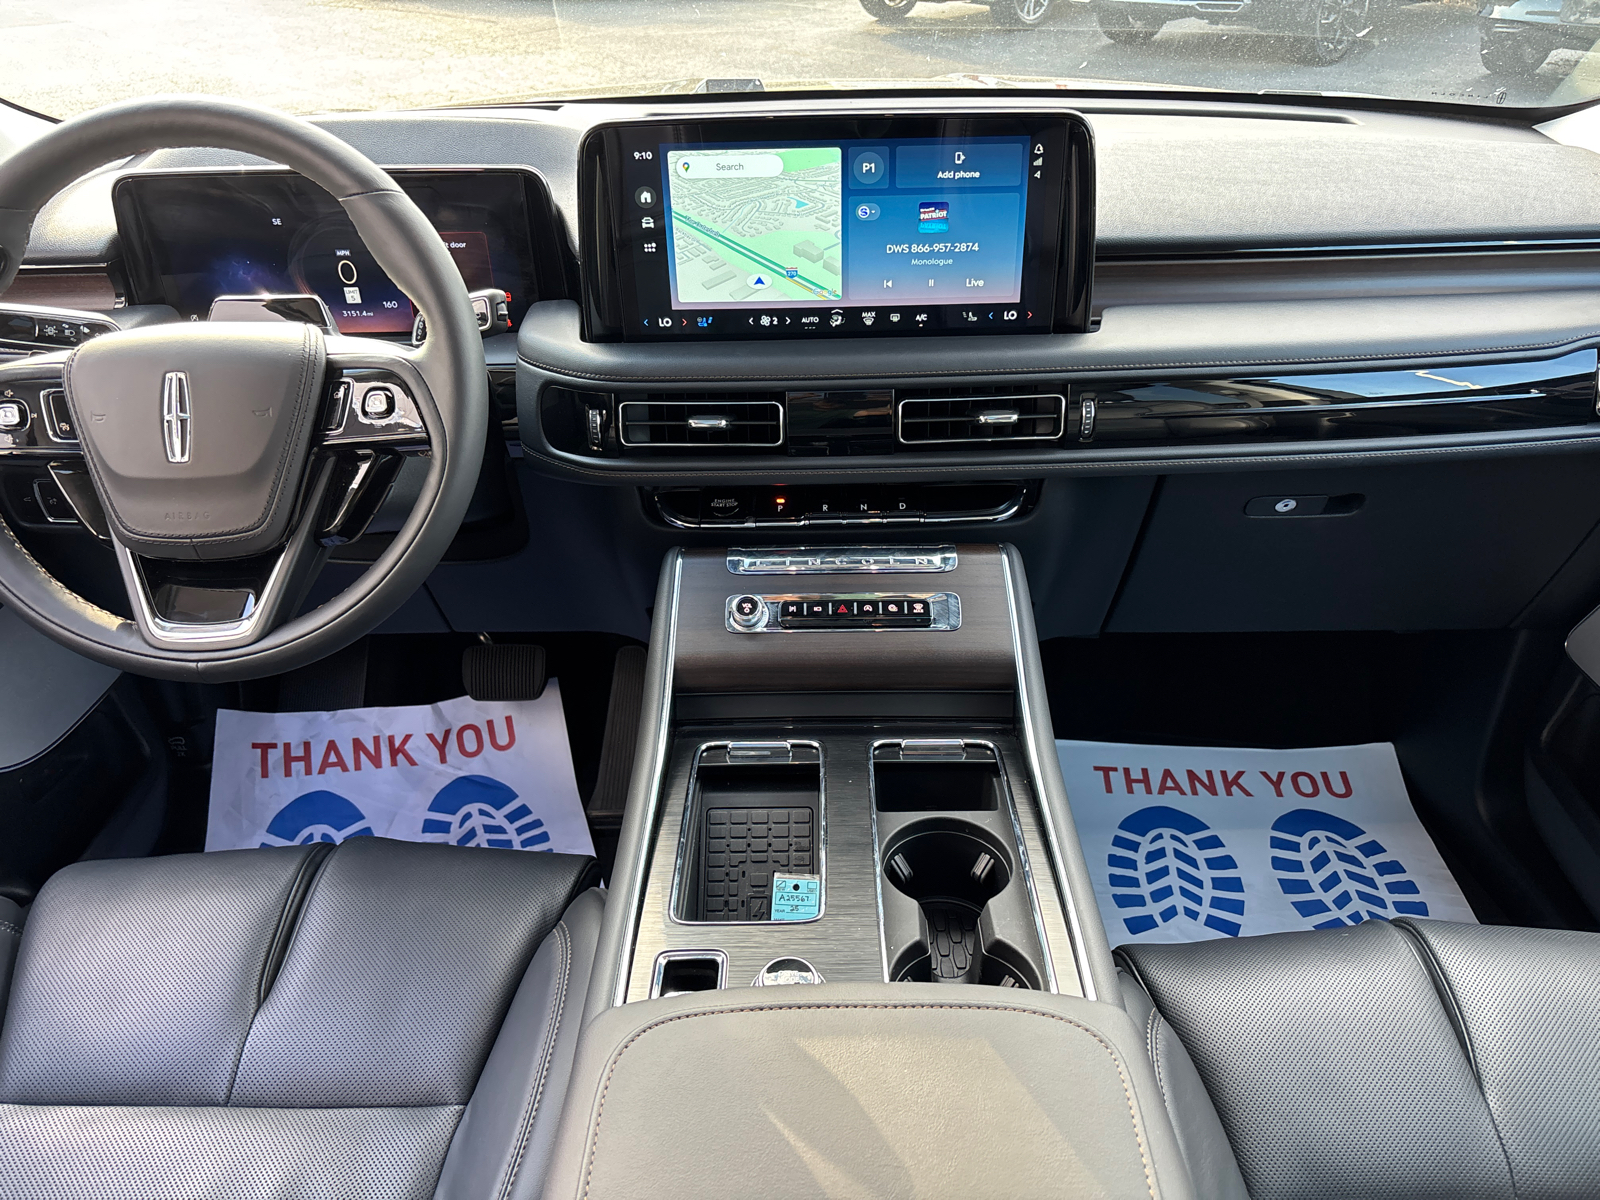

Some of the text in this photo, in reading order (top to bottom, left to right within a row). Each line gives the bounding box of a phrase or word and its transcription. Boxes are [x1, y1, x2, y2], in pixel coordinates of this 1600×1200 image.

[633, 151, 653, 160] 9:10
[715, 162, 744, 171] Search
[862, 162, 876, 174] P1
[937, 170, 980, 180] Add phone
[920, 209, 948, 220] PATRIOT
[271, 217, 283, 226] SE
[449, 241, 467, 249] door
[886, 242, 980, 254] DWS 866-957-2874
[911, 257, 953, 267] Monologue
[338, 260, 357, 284] 0
[966, 278, 985, 287] Live
[382, 300, 398, 309] 160
[915, 313, 928, 322] A/C
[1003, 310, 1018, 321] LO
[658, 317, 673, 328] LO
[772, 316, 779, 325] 2
[777, 504, 784, 513] P
[822, 504, 829, 512] R
[860, 503, 868, 511] N
[899, 502, 906, 510] D
[755, 556, 929, 567] LINCOLN
[251, 715, 517, 779] THANK YOU
[1093, 765, 1354, 799] THANK YOU
